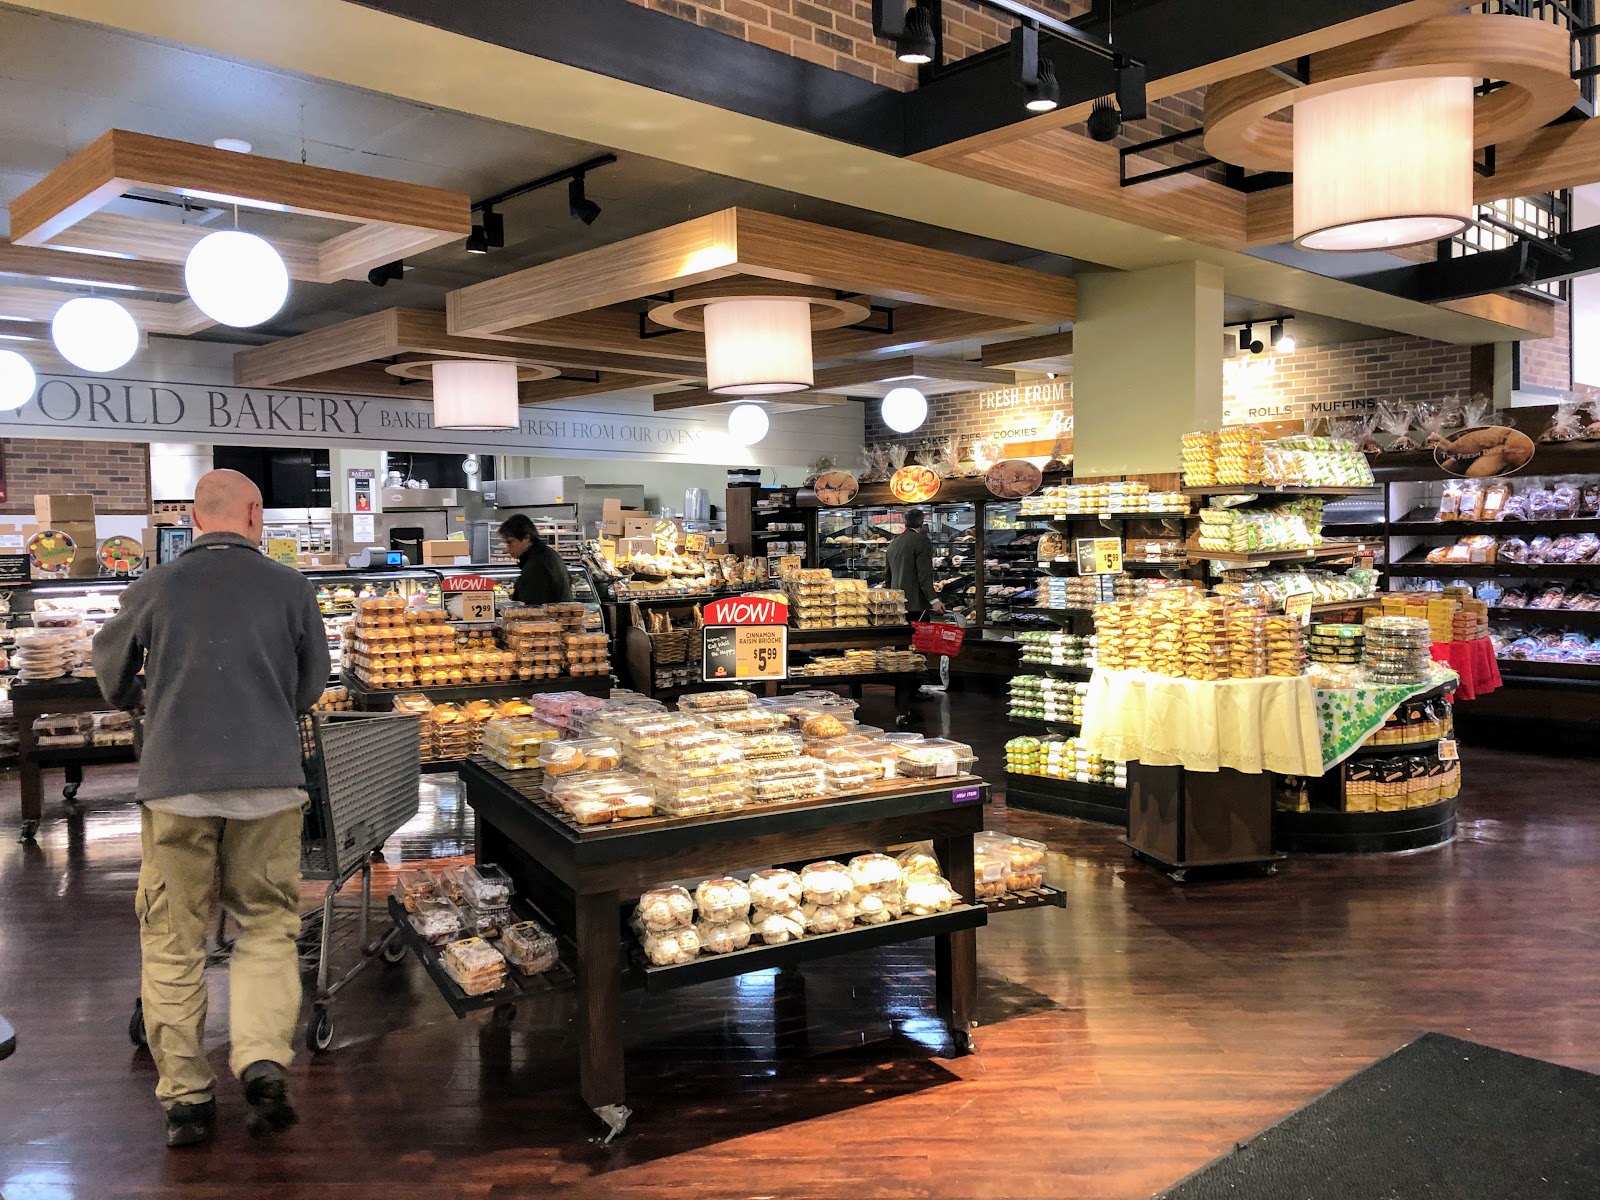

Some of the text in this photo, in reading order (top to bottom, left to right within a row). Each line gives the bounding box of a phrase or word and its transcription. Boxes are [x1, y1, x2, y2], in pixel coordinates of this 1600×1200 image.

[979, 387, 1019, 409] FRESH
[1024, 383, 1064, 404] FROM
[15, 379, 368, 434] ORLD BAKERY
[1248, 405, 1292, 418] ROLLS
[1311, 398, 1376, 412] MUFFINS
[520, 419, 566, 437] FRESH
[572, 422, 615, 440] FROM
[620, 425, 652, 442] OUR
[657, 429, 703, 445] OVENS
[920, 428, 1037, 446] CAKES PIES COOKIES
[449, 578, 487, 590] WOW!
[716, 603, 775, 622] WOW!
